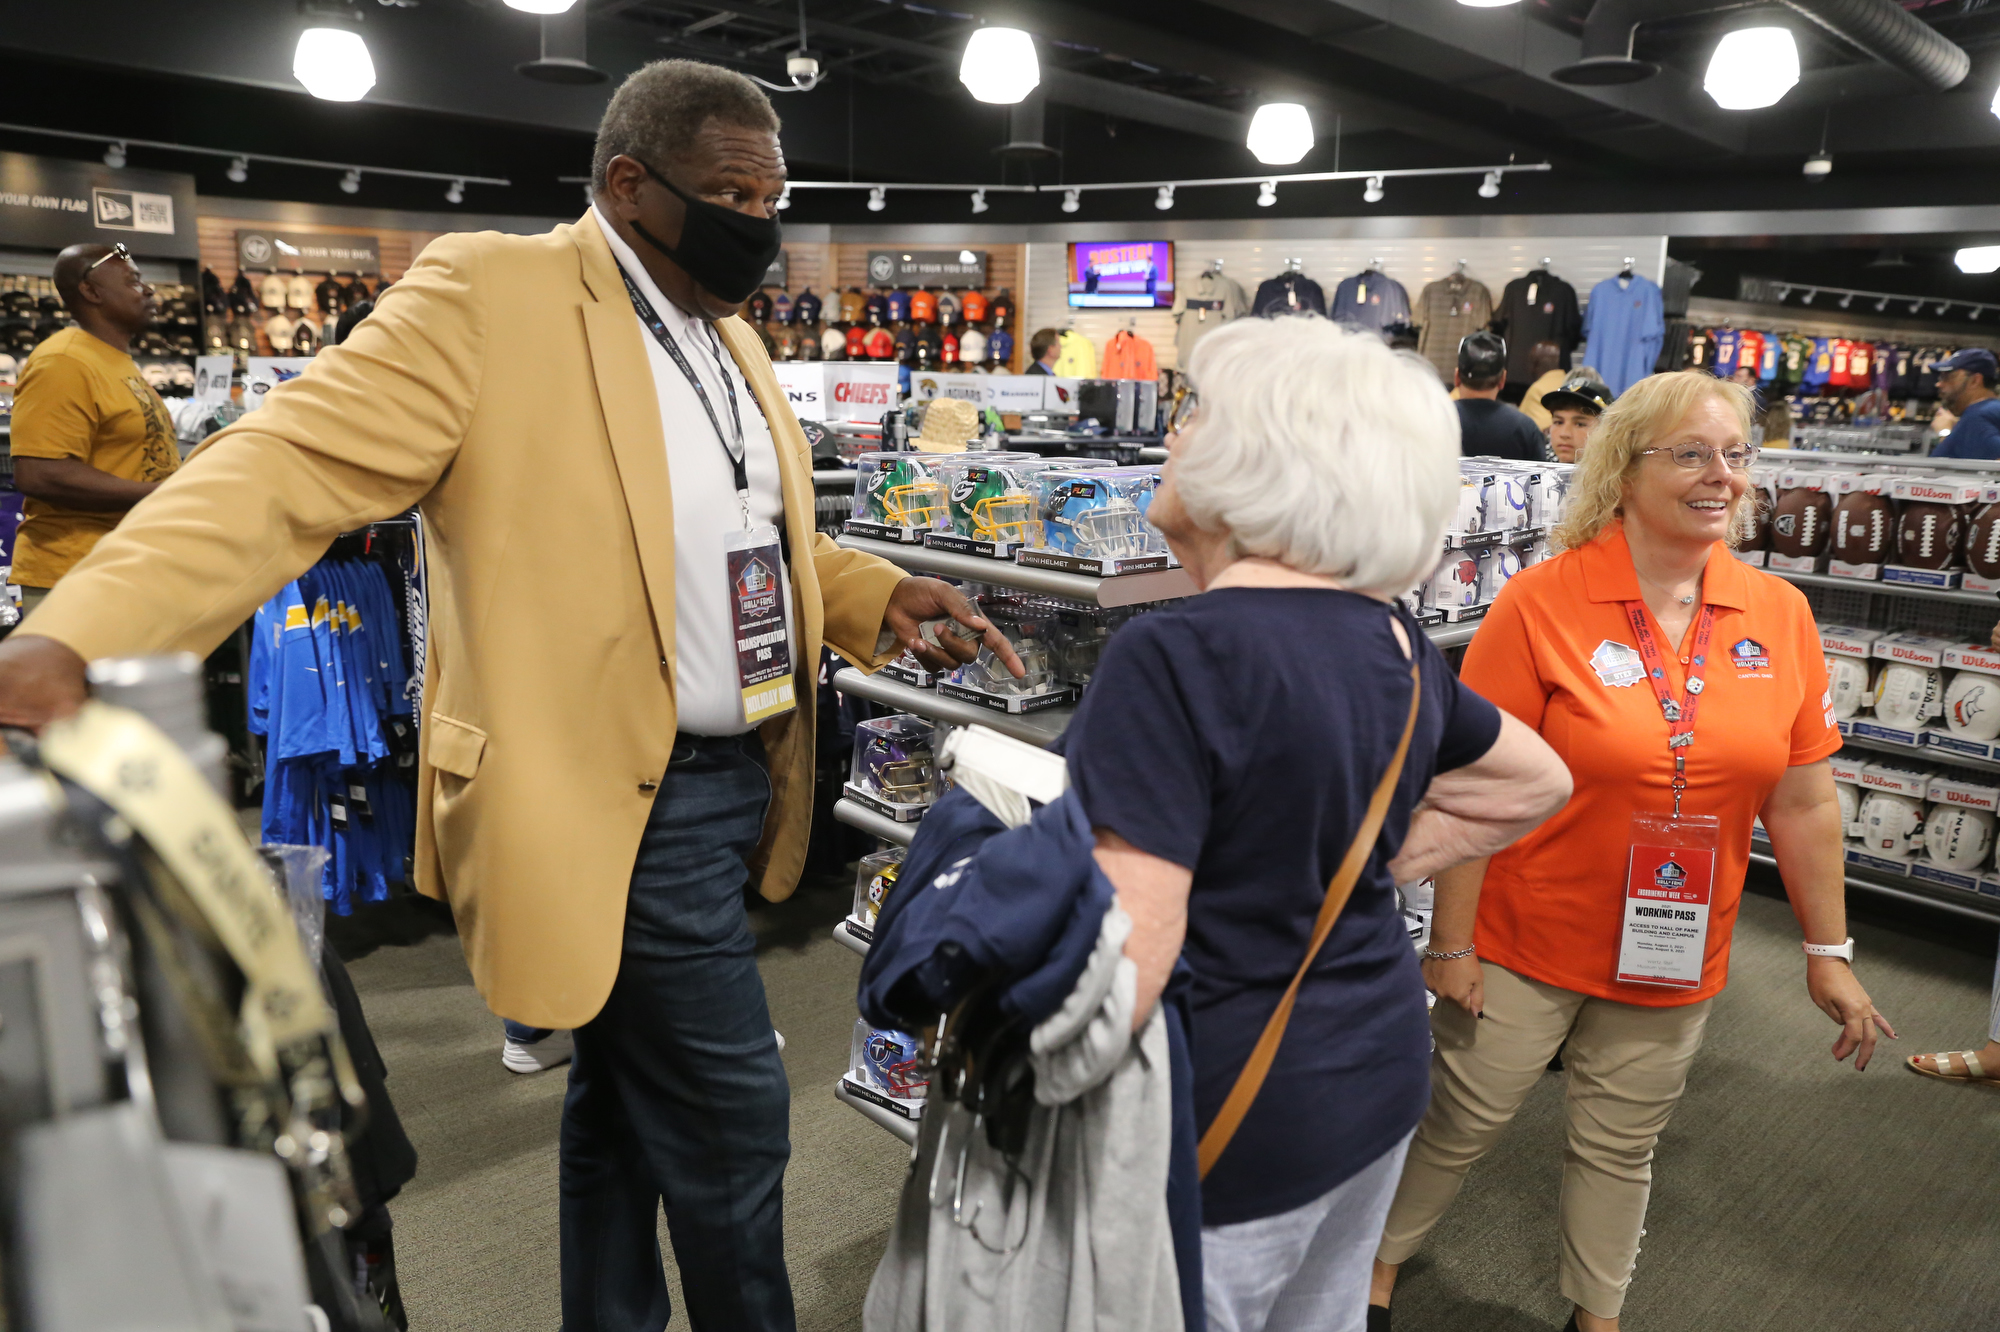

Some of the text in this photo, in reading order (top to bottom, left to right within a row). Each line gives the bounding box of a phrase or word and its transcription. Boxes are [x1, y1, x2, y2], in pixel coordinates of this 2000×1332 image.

[32, 195, 60, 210] OWN
[61, 197, 89, 213] FLAG
[139, 202, 168, 213] NEW
[1088, 242, 1154, 265] BUSTED!
[901, 263, 918, 273] LET
[919, 263, 942, 273] YOUR
[943, 263, 960, 274] YOU
[834, 382, 891, 405] CHIEFS
[943, 388, 982, 403] JAGUARS
[1910, 486, 1953, 500] Wilson
[850, 524, 900, 539] MINI HELMET Riddell
[932, 539, 993, 555] MINI HELMET Riddell
[1025, 556, 1099, 572] MINI HELMET Riddell
[1134, 561, 1158, 569] HELMET
[1636, 608, 1647, 627] FAME
[737, 628, 787, 653] TRANSPORTATION
[1631, 608, 1652, 658] PRO FOOTBALL
[756, 646, 773, 662] PASS
[1648, 639, 1657, 657] HALL
[1823, 638, 1863, 654] Wilson
[1892, 647, 1934, 664] Wilson
[745, 683, 794, 715] HOLIDAY INN
[944, 687, 1006, 709] MINI HELMET Riddell
[1040, 695, 1063, 706] HELMET
[1832, 767, 1855, 780] lson
[1862, 773, 1902, 790] Wilson
[858, 795, 876, 808] HELMET
[1947, 790, 1991, 807] Wilson
[1948, 808, 1966, 860] TEXANS
[1668, 891, 1681, 899] WEEK
[1635, 906, 1696, 921] WORKING PASS
[850, 1084, 907, 1115] MINI HELMET Riddell
